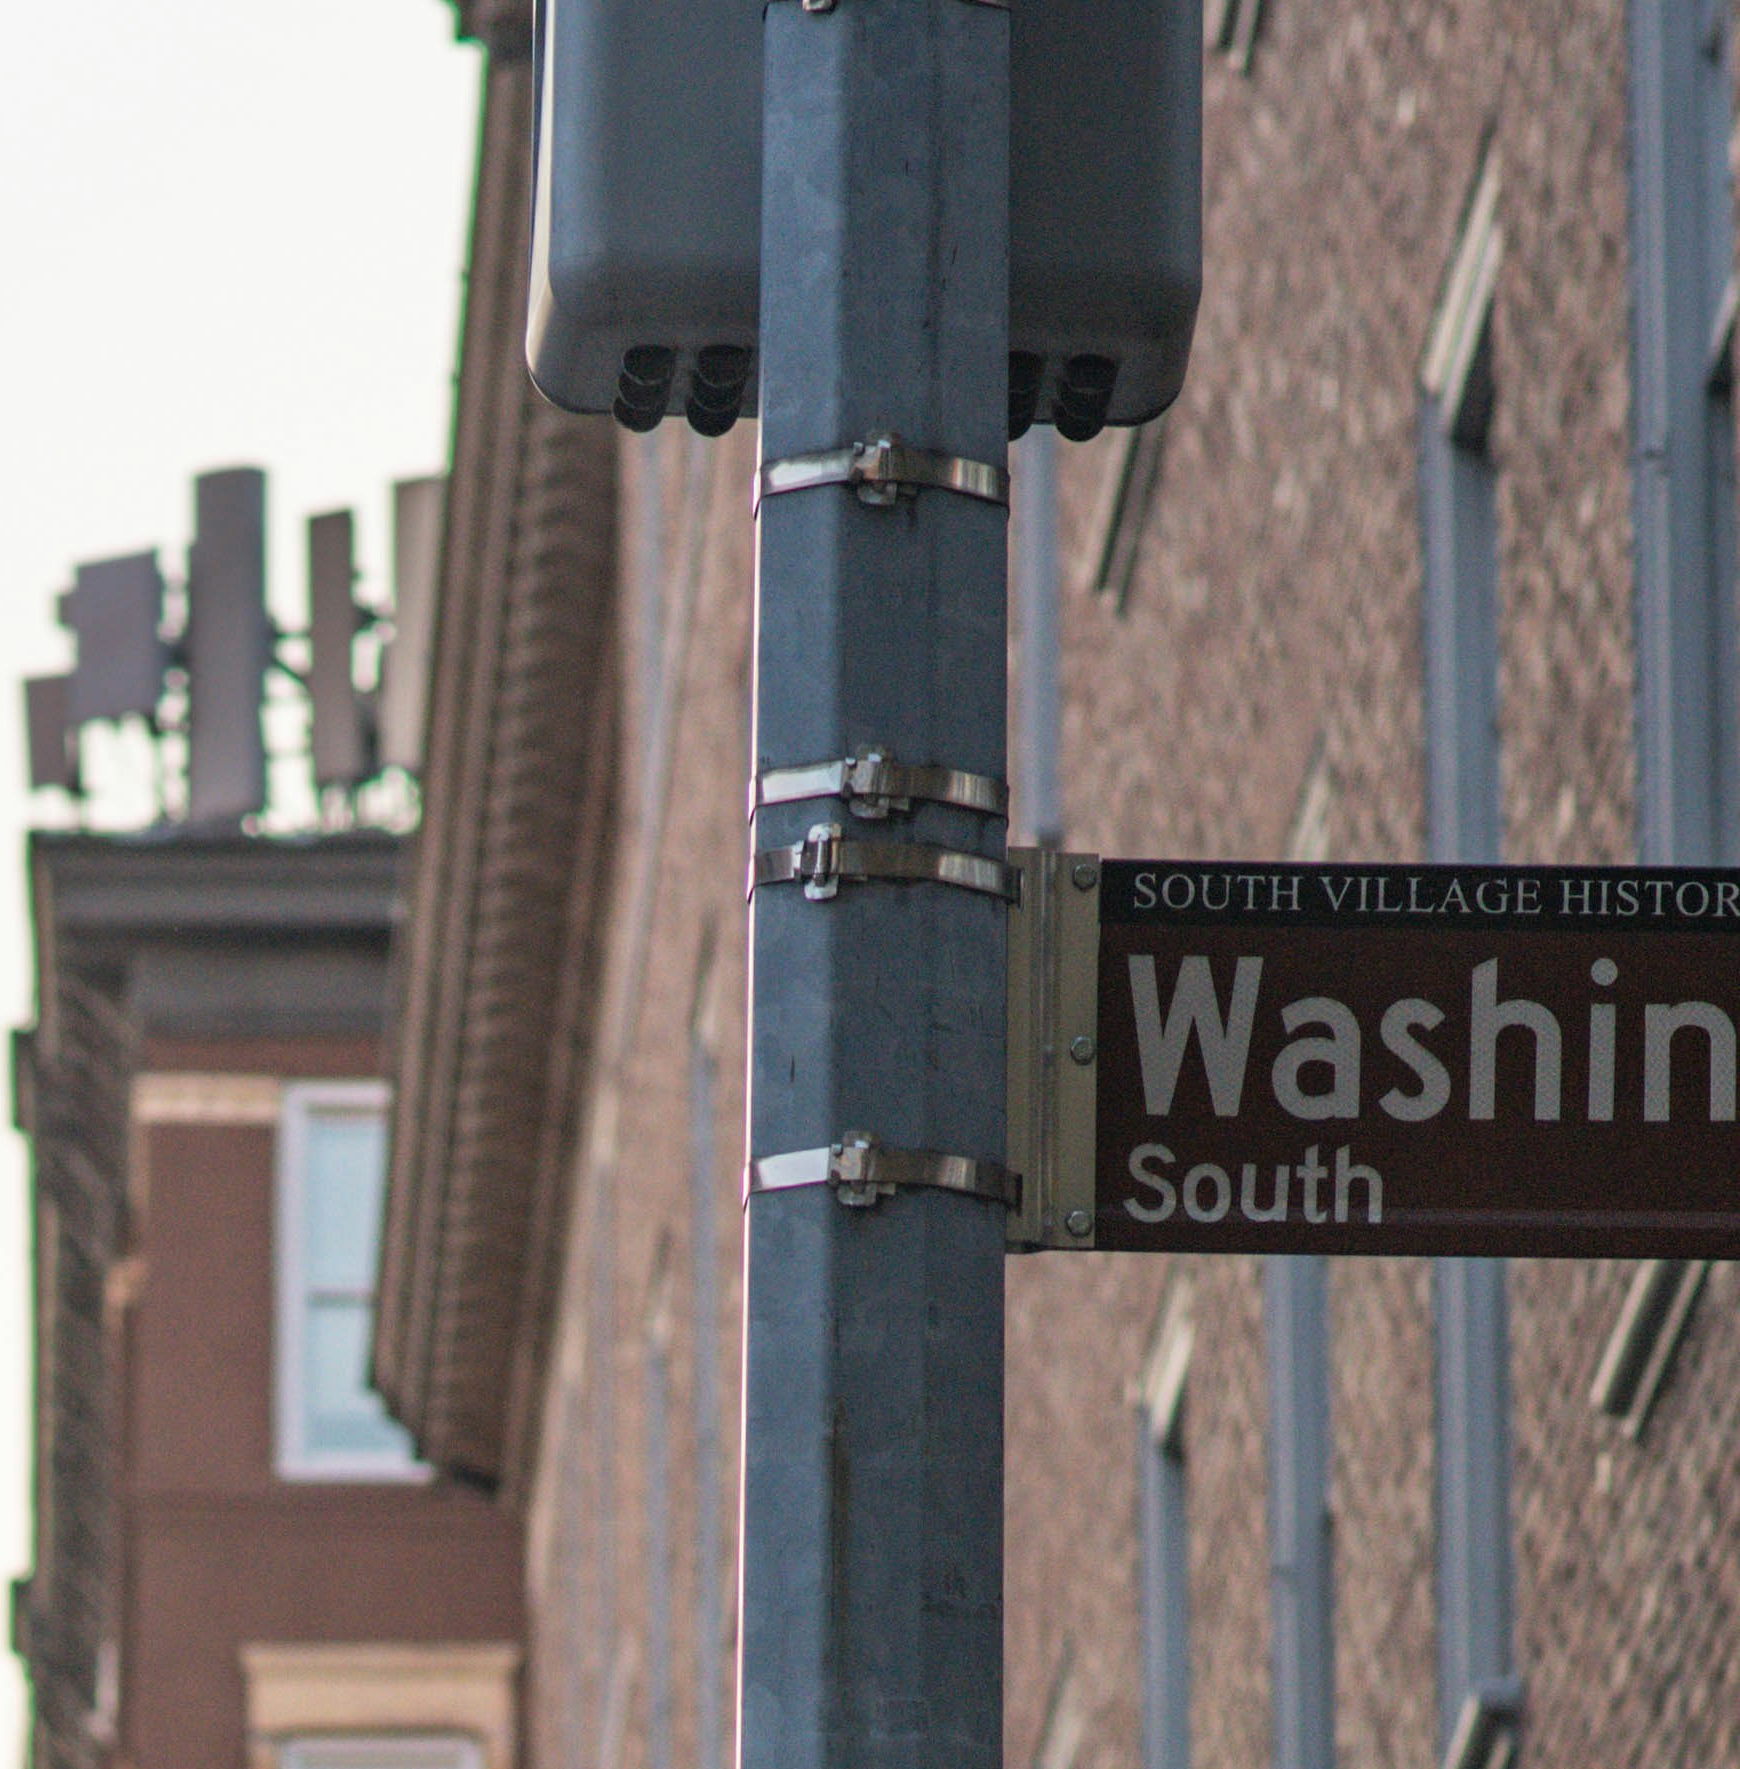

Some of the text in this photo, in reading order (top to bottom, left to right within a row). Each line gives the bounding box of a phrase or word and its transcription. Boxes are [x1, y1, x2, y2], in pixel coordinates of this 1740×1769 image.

[1133, 872, 1740, 917] SOUTH VILLAGE HISTOR
[1127, 954, 1738, 1122] Washin
[1122, 1142, 1384, 1224] South
